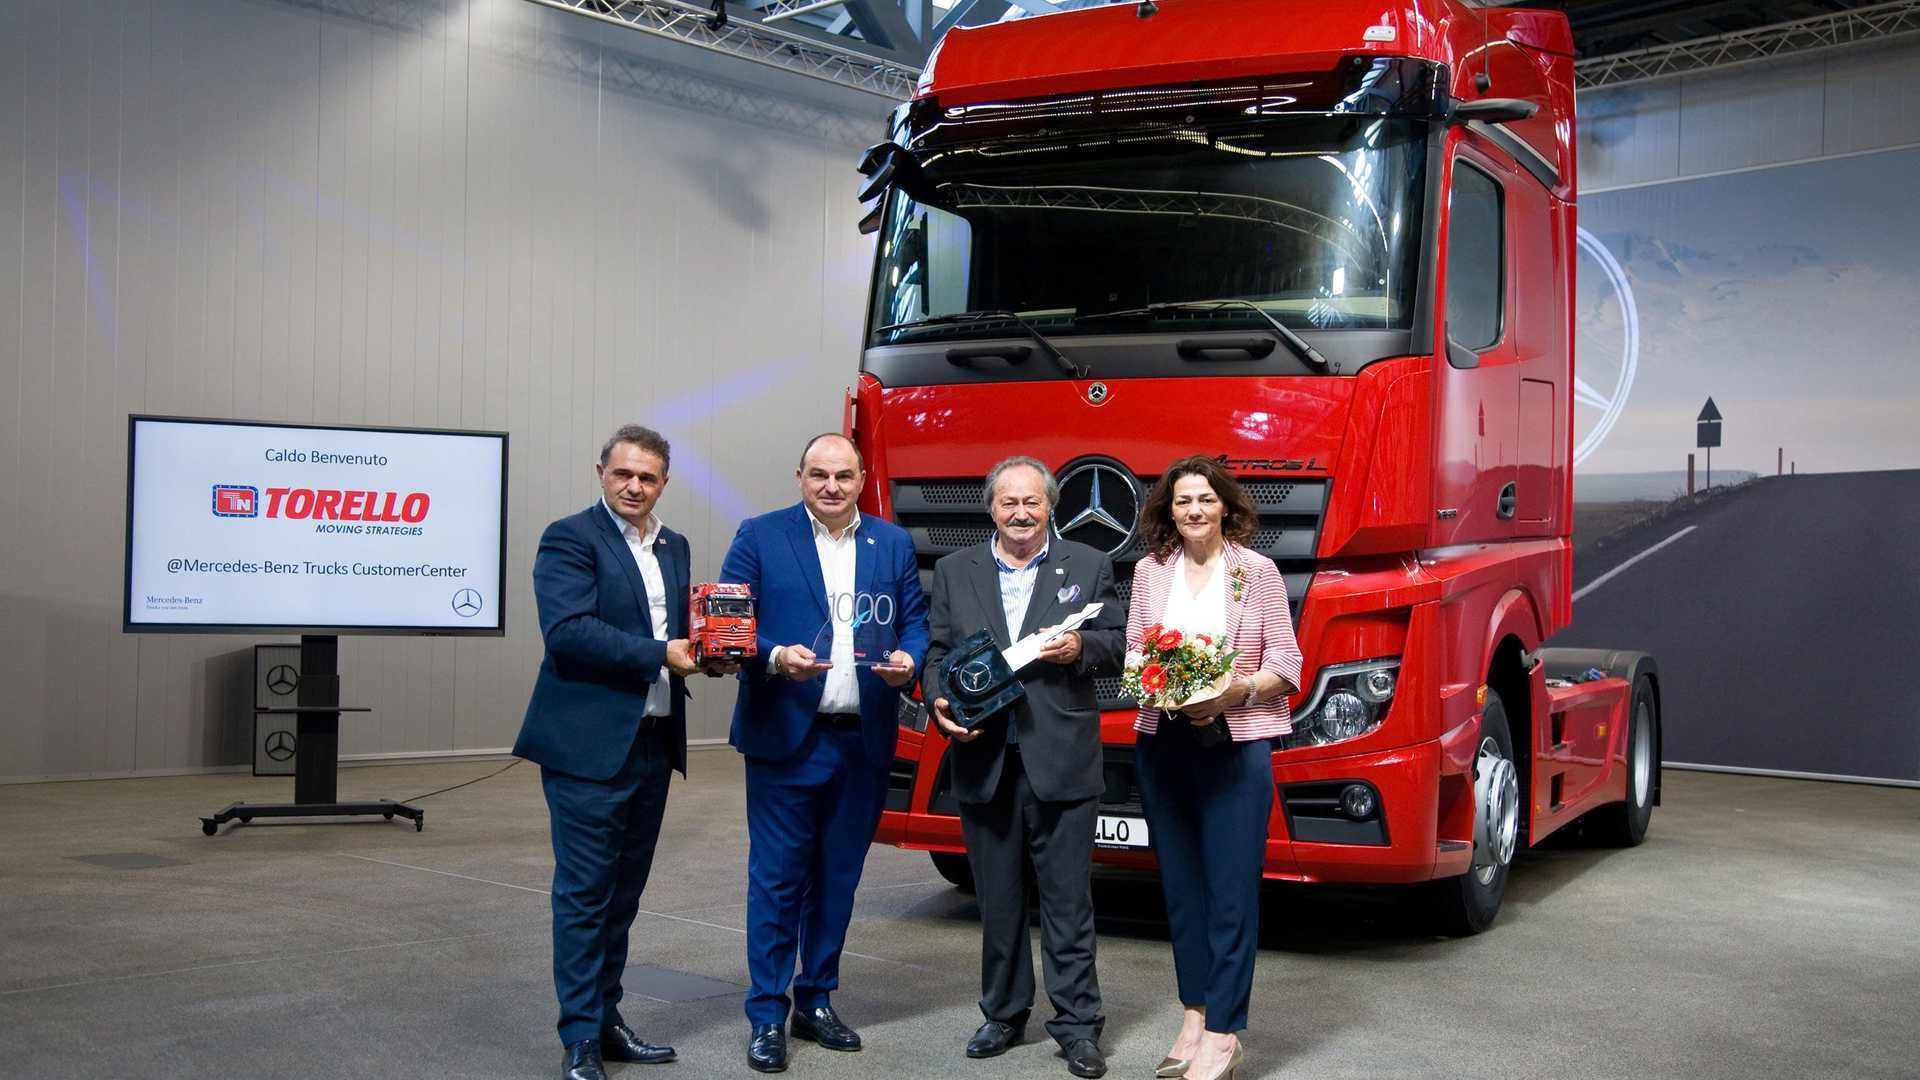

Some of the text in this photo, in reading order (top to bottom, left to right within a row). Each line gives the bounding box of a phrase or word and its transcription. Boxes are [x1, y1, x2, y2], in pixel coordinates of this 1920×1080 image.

[265, 449, 388, 466] Caldo Benvenuto
[265, 488, 430, 523] TORELLO
[315, 524, 423, 536] MOVING STRATEGIES
[167, 559, 468, 578] @Mercedes-Benz Trucks CustomerCenter
[828, 591, 893, 625] 1000
[1095, 819, 1130, 842] LO
